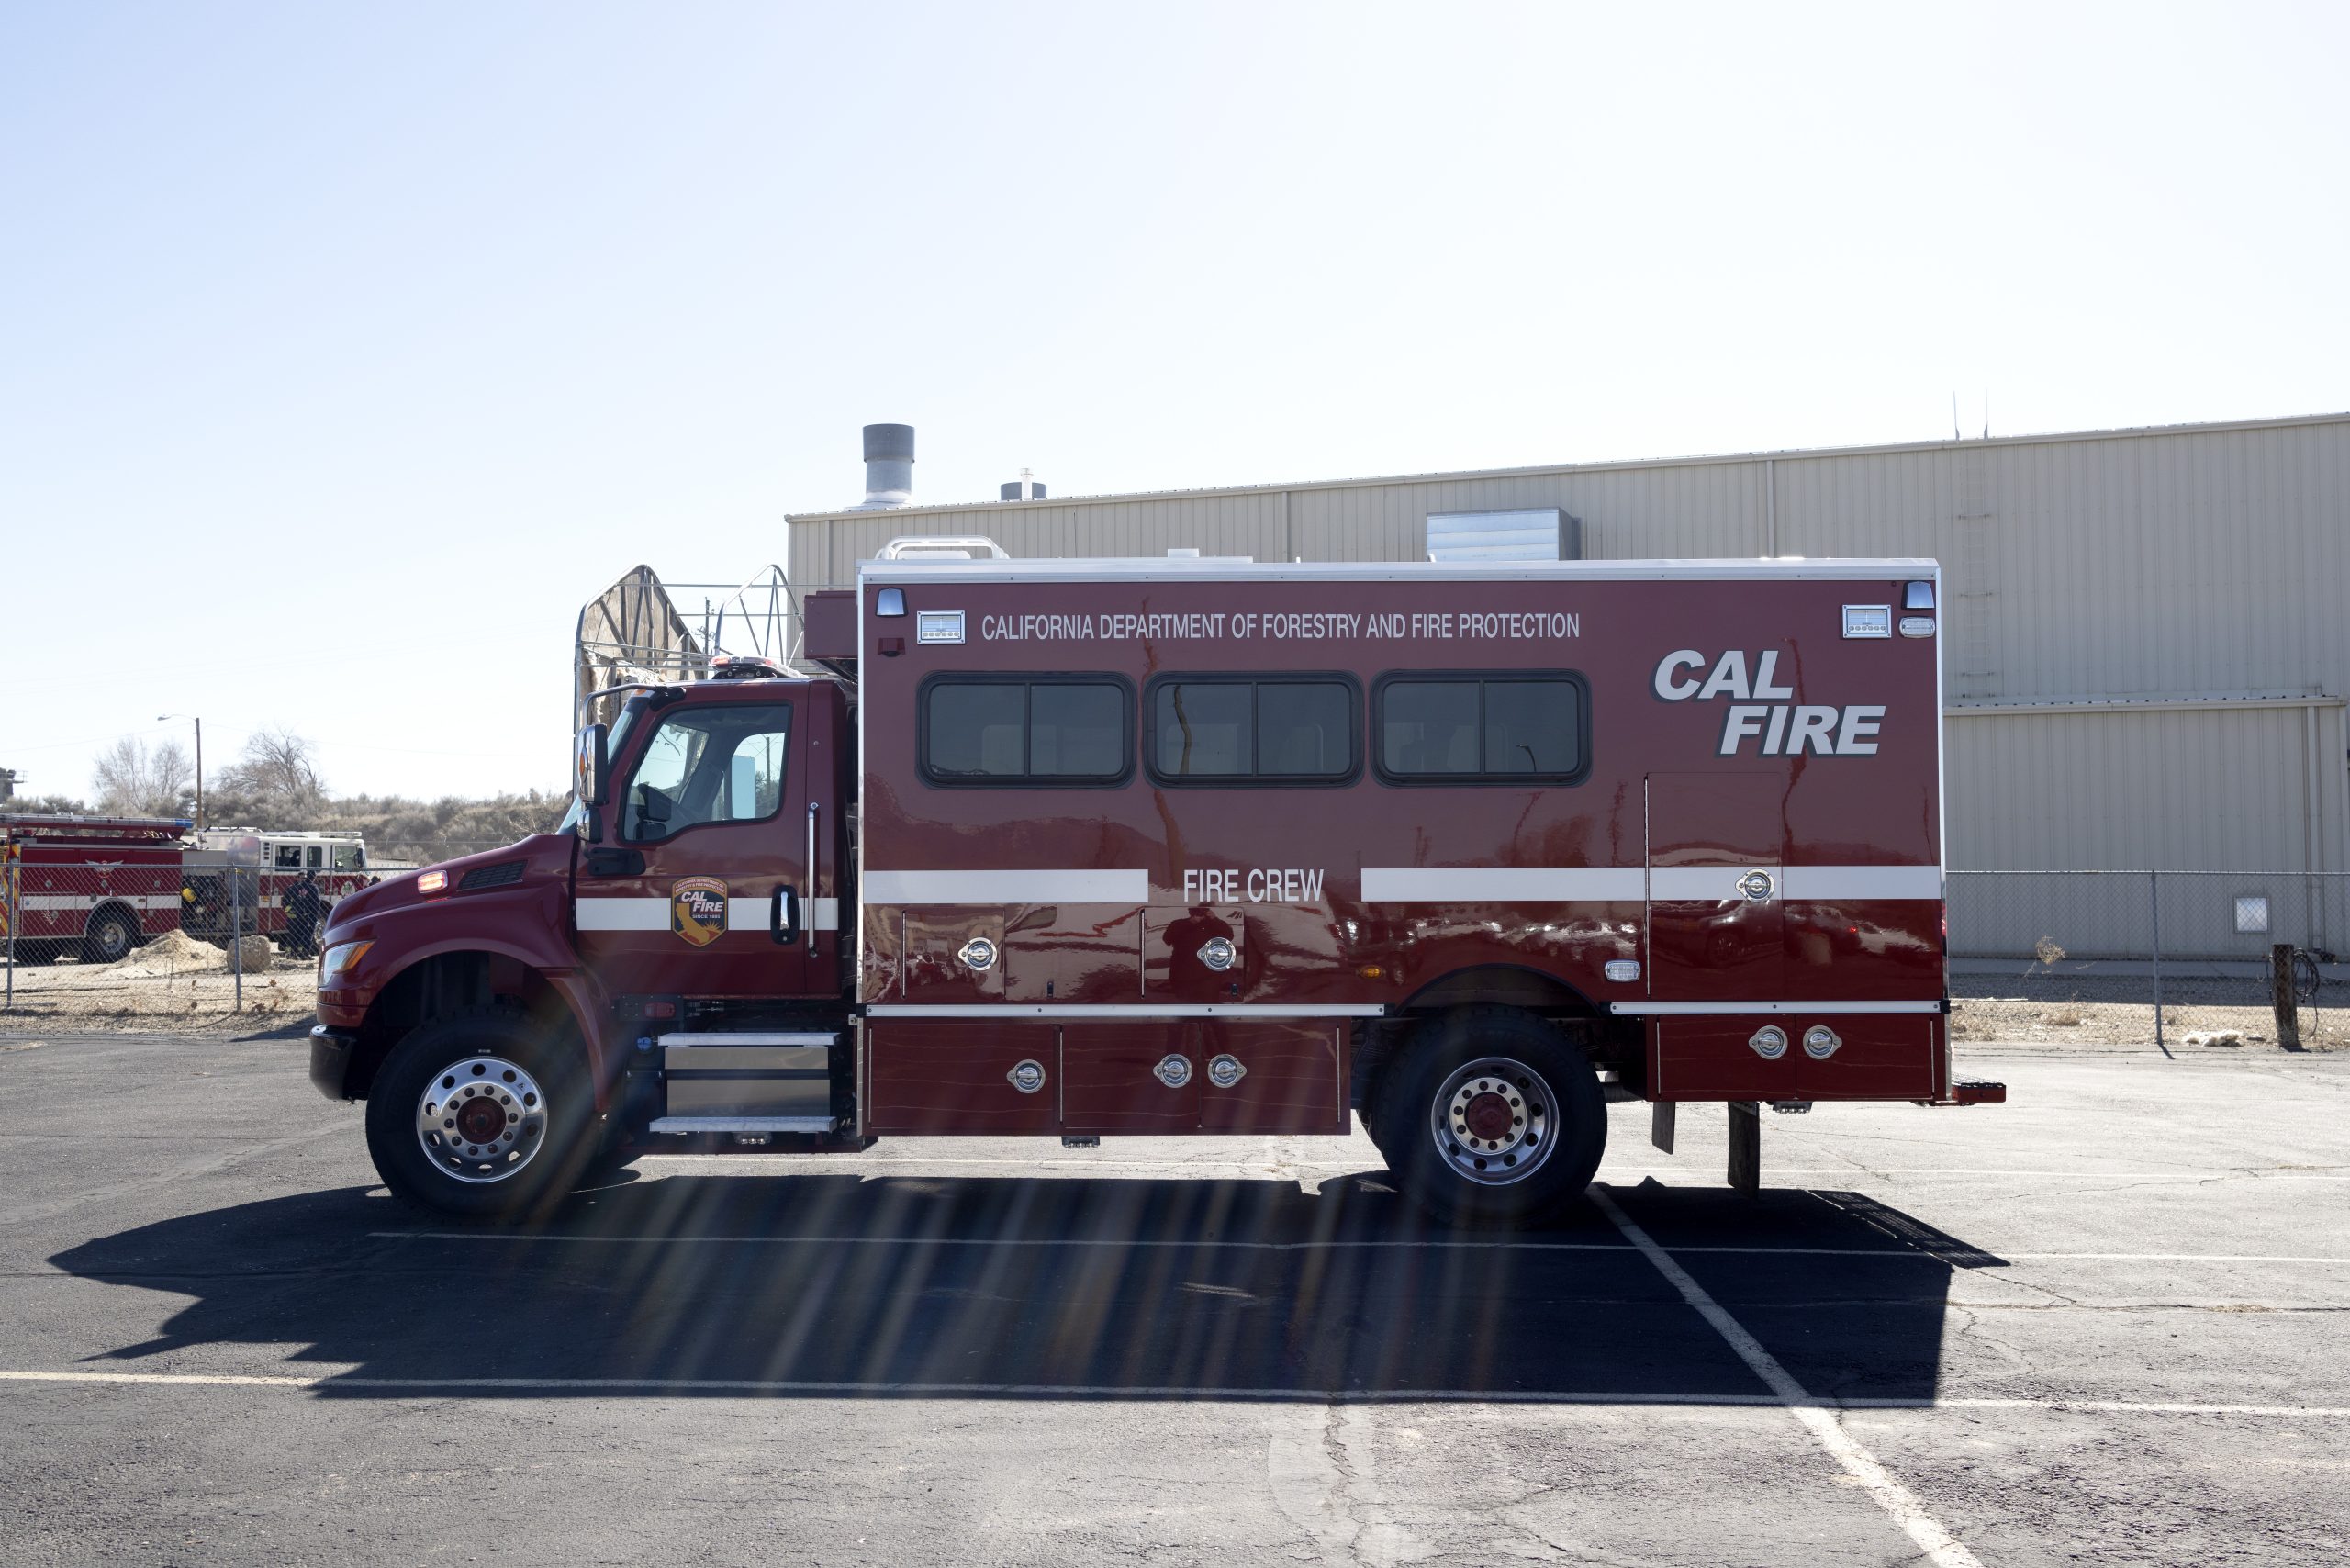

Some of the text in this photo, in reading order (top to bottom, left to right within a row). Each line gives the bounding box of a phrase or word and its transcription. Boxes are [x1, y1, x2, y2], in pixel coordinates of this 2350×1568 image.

[982, 612, 1580, 640] CALIFORNIA DEPARTMENT OF FORESTRY AND FIRE PROTECTION
[1653, 649, 1794, 700] CAL
[1719, 705, 1886, 755] FIRE
[681, 891, 707, 902] CAL
[1183, 868, 1325, 902] FIRE CREW
[692, 902, 724, 913] FIRE
